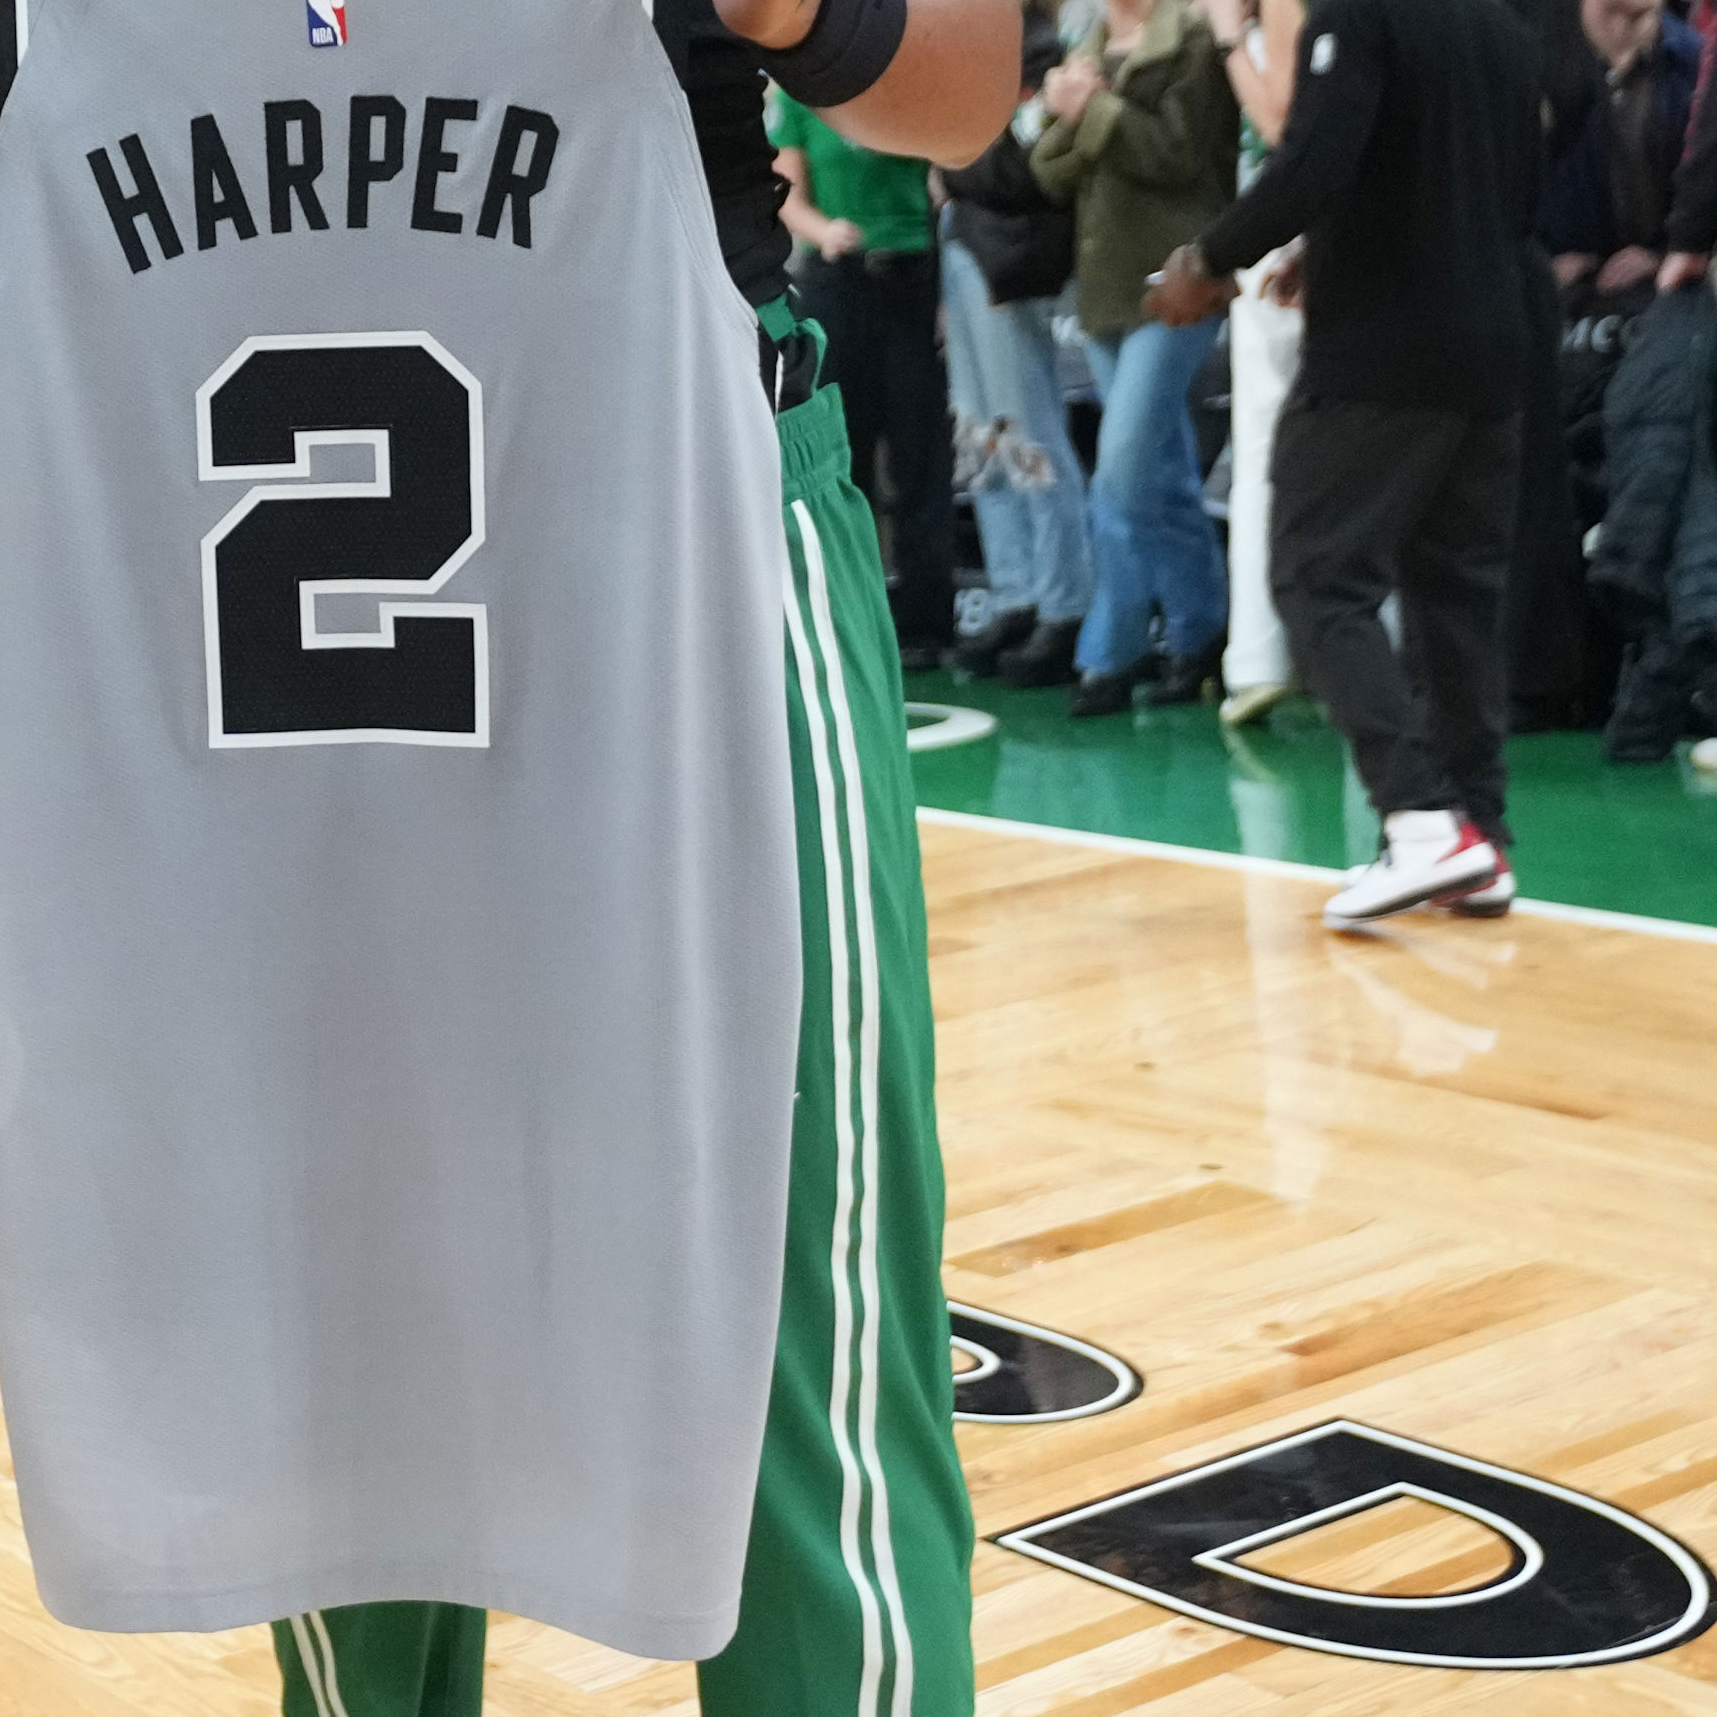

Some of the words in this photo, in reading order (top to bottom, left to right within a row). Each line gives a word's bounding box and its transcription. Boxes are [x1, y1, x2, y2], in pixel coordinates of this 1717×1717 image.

[311, 26, 334, 45] NBA
[86, 94, 560, 275] HARPER
[195, 329, 491, 749] 2
